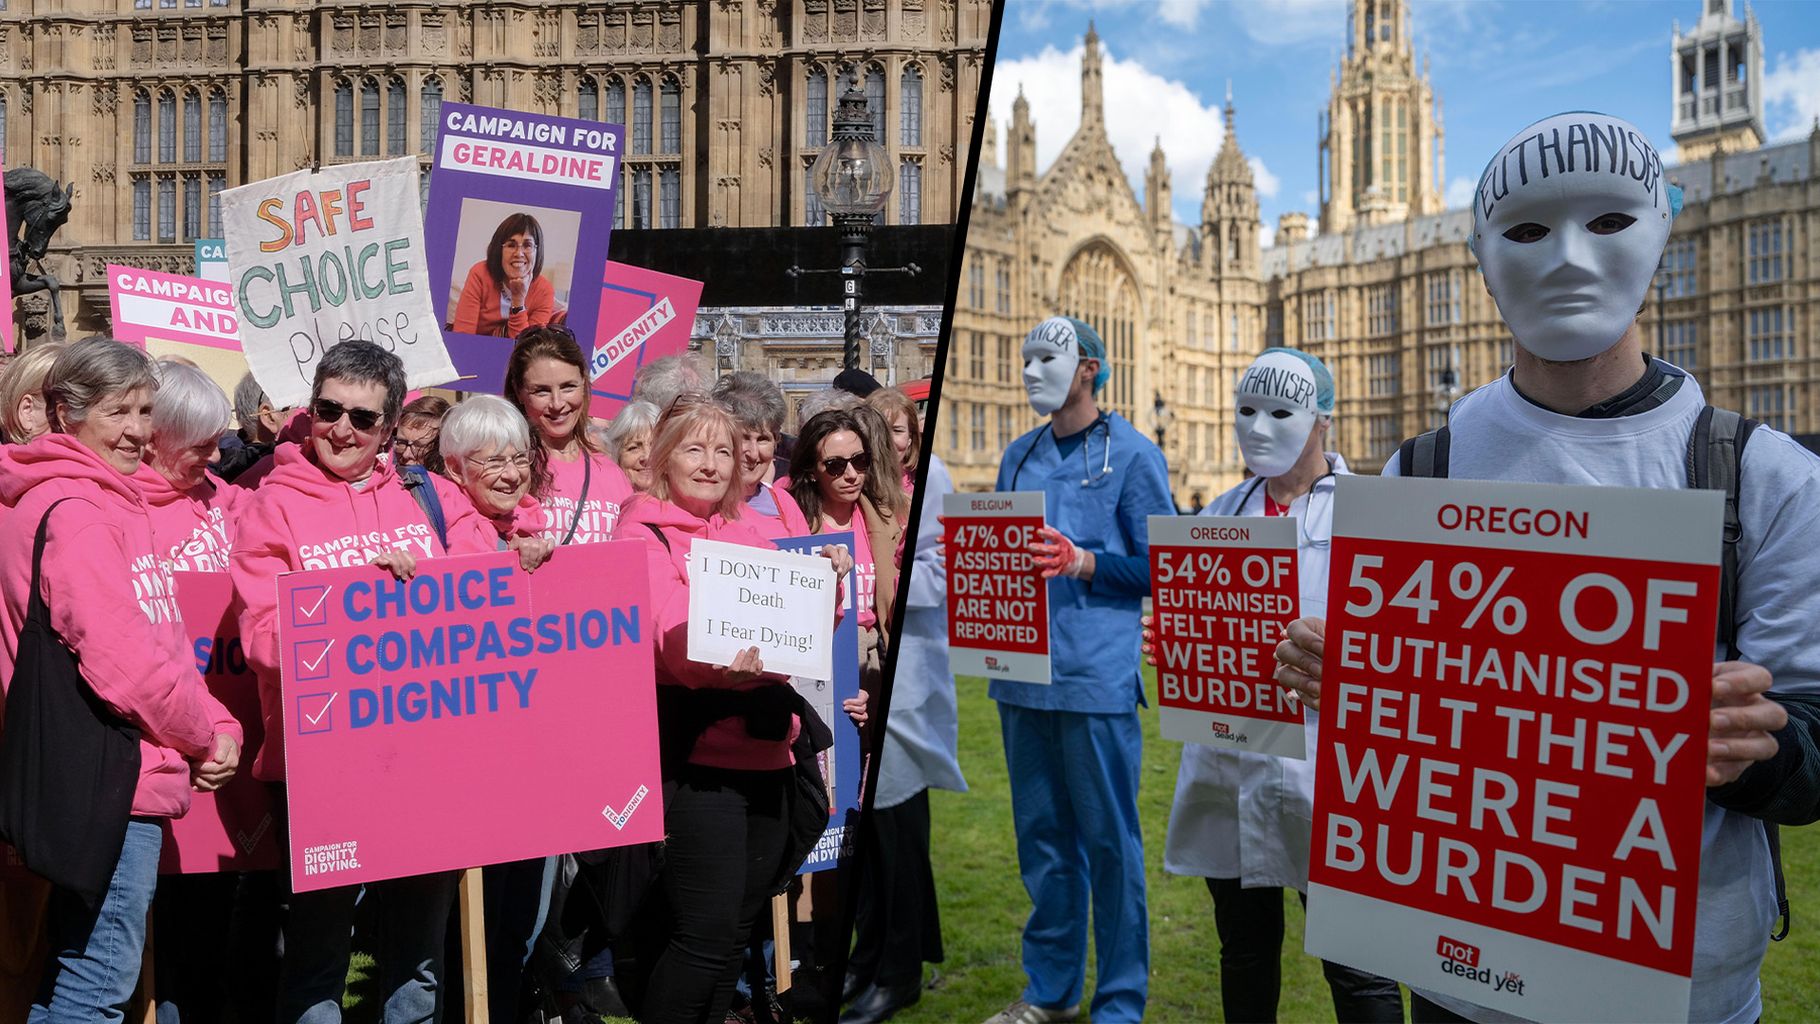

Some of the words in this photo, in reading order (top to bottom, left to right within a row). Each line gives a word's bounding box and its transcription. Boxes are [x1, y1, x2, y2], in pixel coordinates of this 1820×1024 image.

[446, 112, 566, 145] CAMPAIGN
[572, 128, 617, 151] FOR
[453, 143, 604, 181] GERALDINE
[1480, 123, 1660, 221] EUTHANISER
[257, 180, 374, 252] SAFE
[239, 237, 413, 329] CHOICE
[971, 500, 1013, 511] BELGIUM
[1437, 503, 1589, 539] OREGON
[394, 523, 430, 539] FOR
[953, 525, 998, 548] 47%
[1004, 525, 1035, 548] OF
[1190, 527, 1250, 540] OREGON
[703, 557, 709, 572] I
[720, 559, 781, 583] DON'T
[789, 570, 824, 590] Fear
[954, 551, 1034, 571] ASSISTED
[1157, 552, 1231, 586] 54%
[1241, 555, 1292, 588] OF
[342, 566, 516, 622] CHOICE
[953, 573, 1036, 598] DEATHS
[1157, 588, 1293, 615] EUTHANISED
[1343, 553, 1527, 636] 54%
[1559, 572, 1698, 652] OF
[955, 598, 991, 619] ARE
[995, 600, 1037, 622] NOT
[1160, 613, 1217, 639] FELT
[345, 605, 641, 676] COMPASSION
[707, 619, 713, 634] I
[721, 620, 755, 641] Fear
[760, 626, 813, 653] Dying!
[955, 622, 1038, 644] REPORTED
[1162, 641, 1260, 677] WERE
[1340, 631, 1689, 714] EUTHANISED
[349, 668, 539, 729] DIGNITY
[1162, 673, 1298, 715] BURDEN
[1336, 682, 1478, 750] FELT
[1495, 705, 1691, 786] THEY
[605, 808, 618, 822] YES
[1333, 742, 1581, 852] WERE
[1612, 798, 1678, 872] A
[304, 843, 341, 854] CAMPAIGN
[342, 840, 358, 849] FOR
[304, 847, 358, 865] DIGNITY
[808, 851, 819, 864] IN
[815, 833, 854, 850] IGNITY
[305, 863, 318, 876] IN
[319, 858, 362, 874] DYING.
[1325, 812, 1677, 951] BURDEN
[1442, 941, 1474, 963] not
[1441, 958, 1491, 984] dead
[1494, 974, 1525, 996] yet
